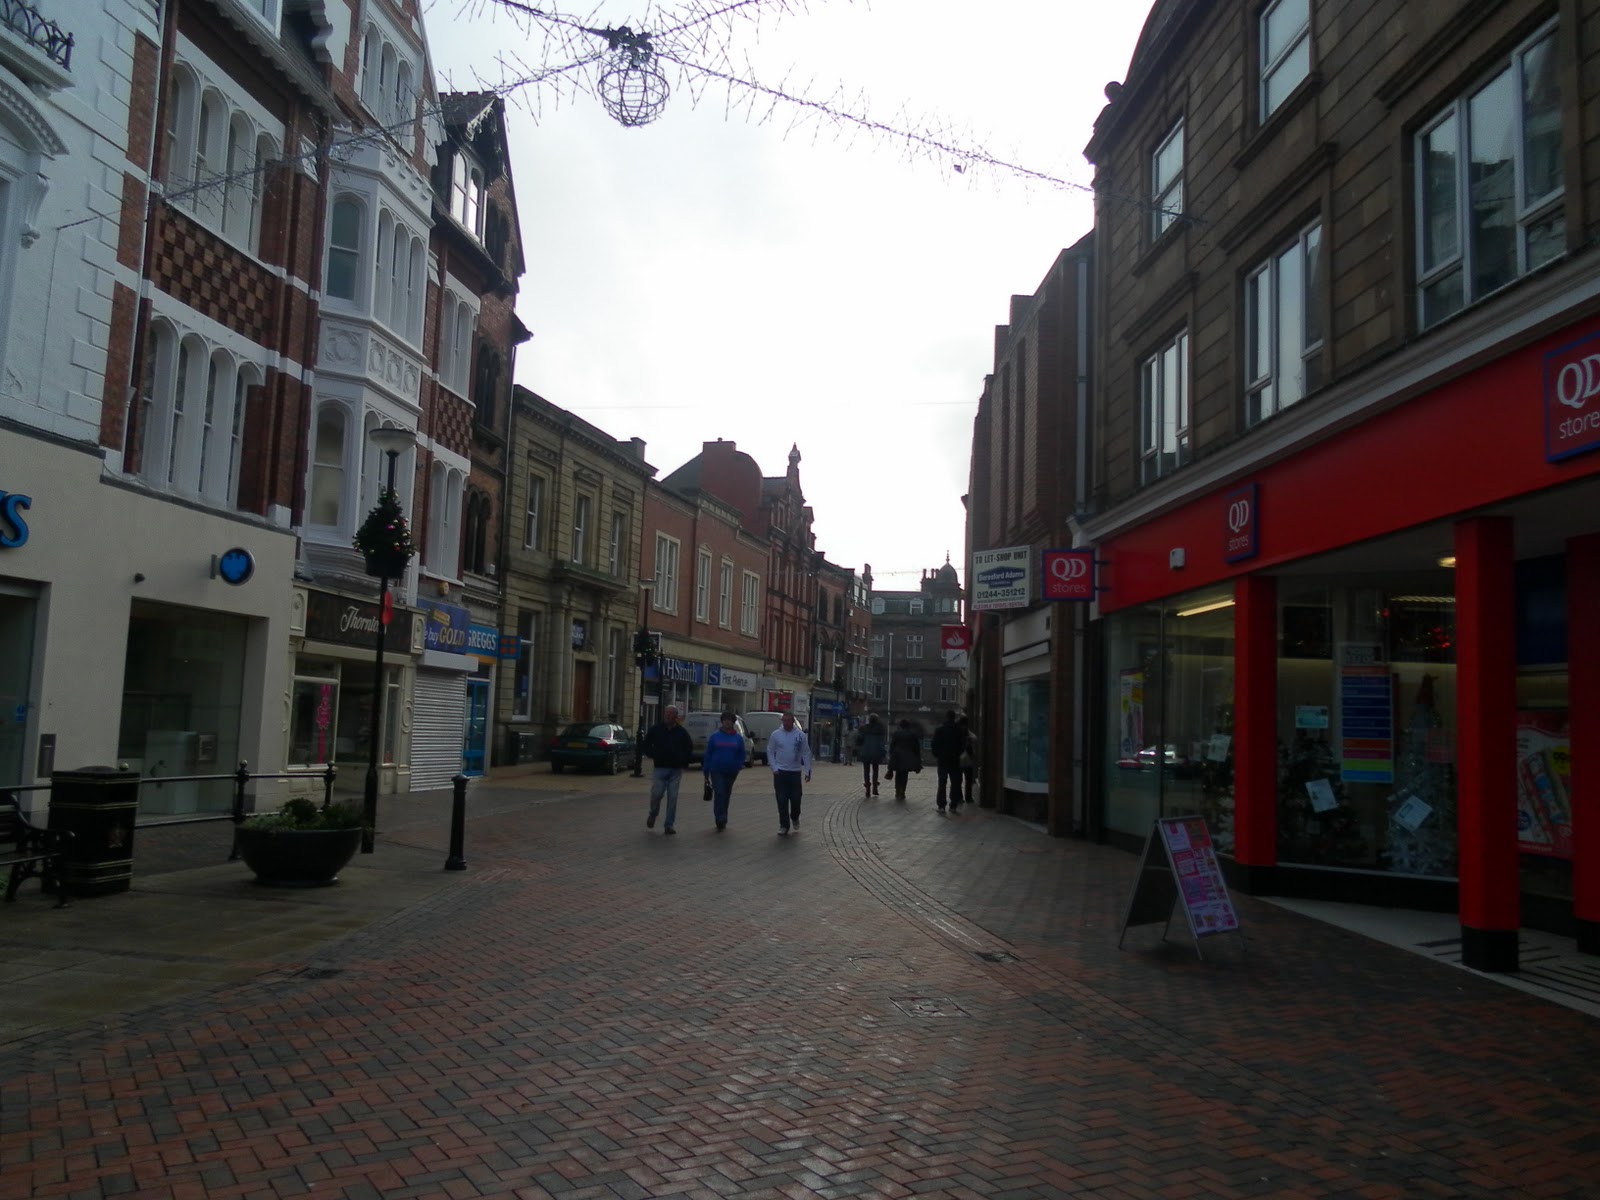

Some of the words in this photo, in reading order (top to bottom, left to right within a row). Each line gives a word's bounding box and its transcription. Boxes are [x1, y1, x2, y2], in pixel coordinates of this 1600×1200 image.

[1557, 353, 1600, 409] QD
[1559, 411, 1600, 439] store
[1228, 500, 1249, 532] QD
[1228, 534, 1249, 551] stores
[978, 571, 1004, 581] Beresford
[1005, 571, 1024, 579] Adams
[1050, 558, 1086, 582] QD
[1052, 581, 1087, 593] stores
[340, 605, 387, 634] Thornto
[428, 627, 439, 645] buy
[439, 627, 465, 647] GOLD
